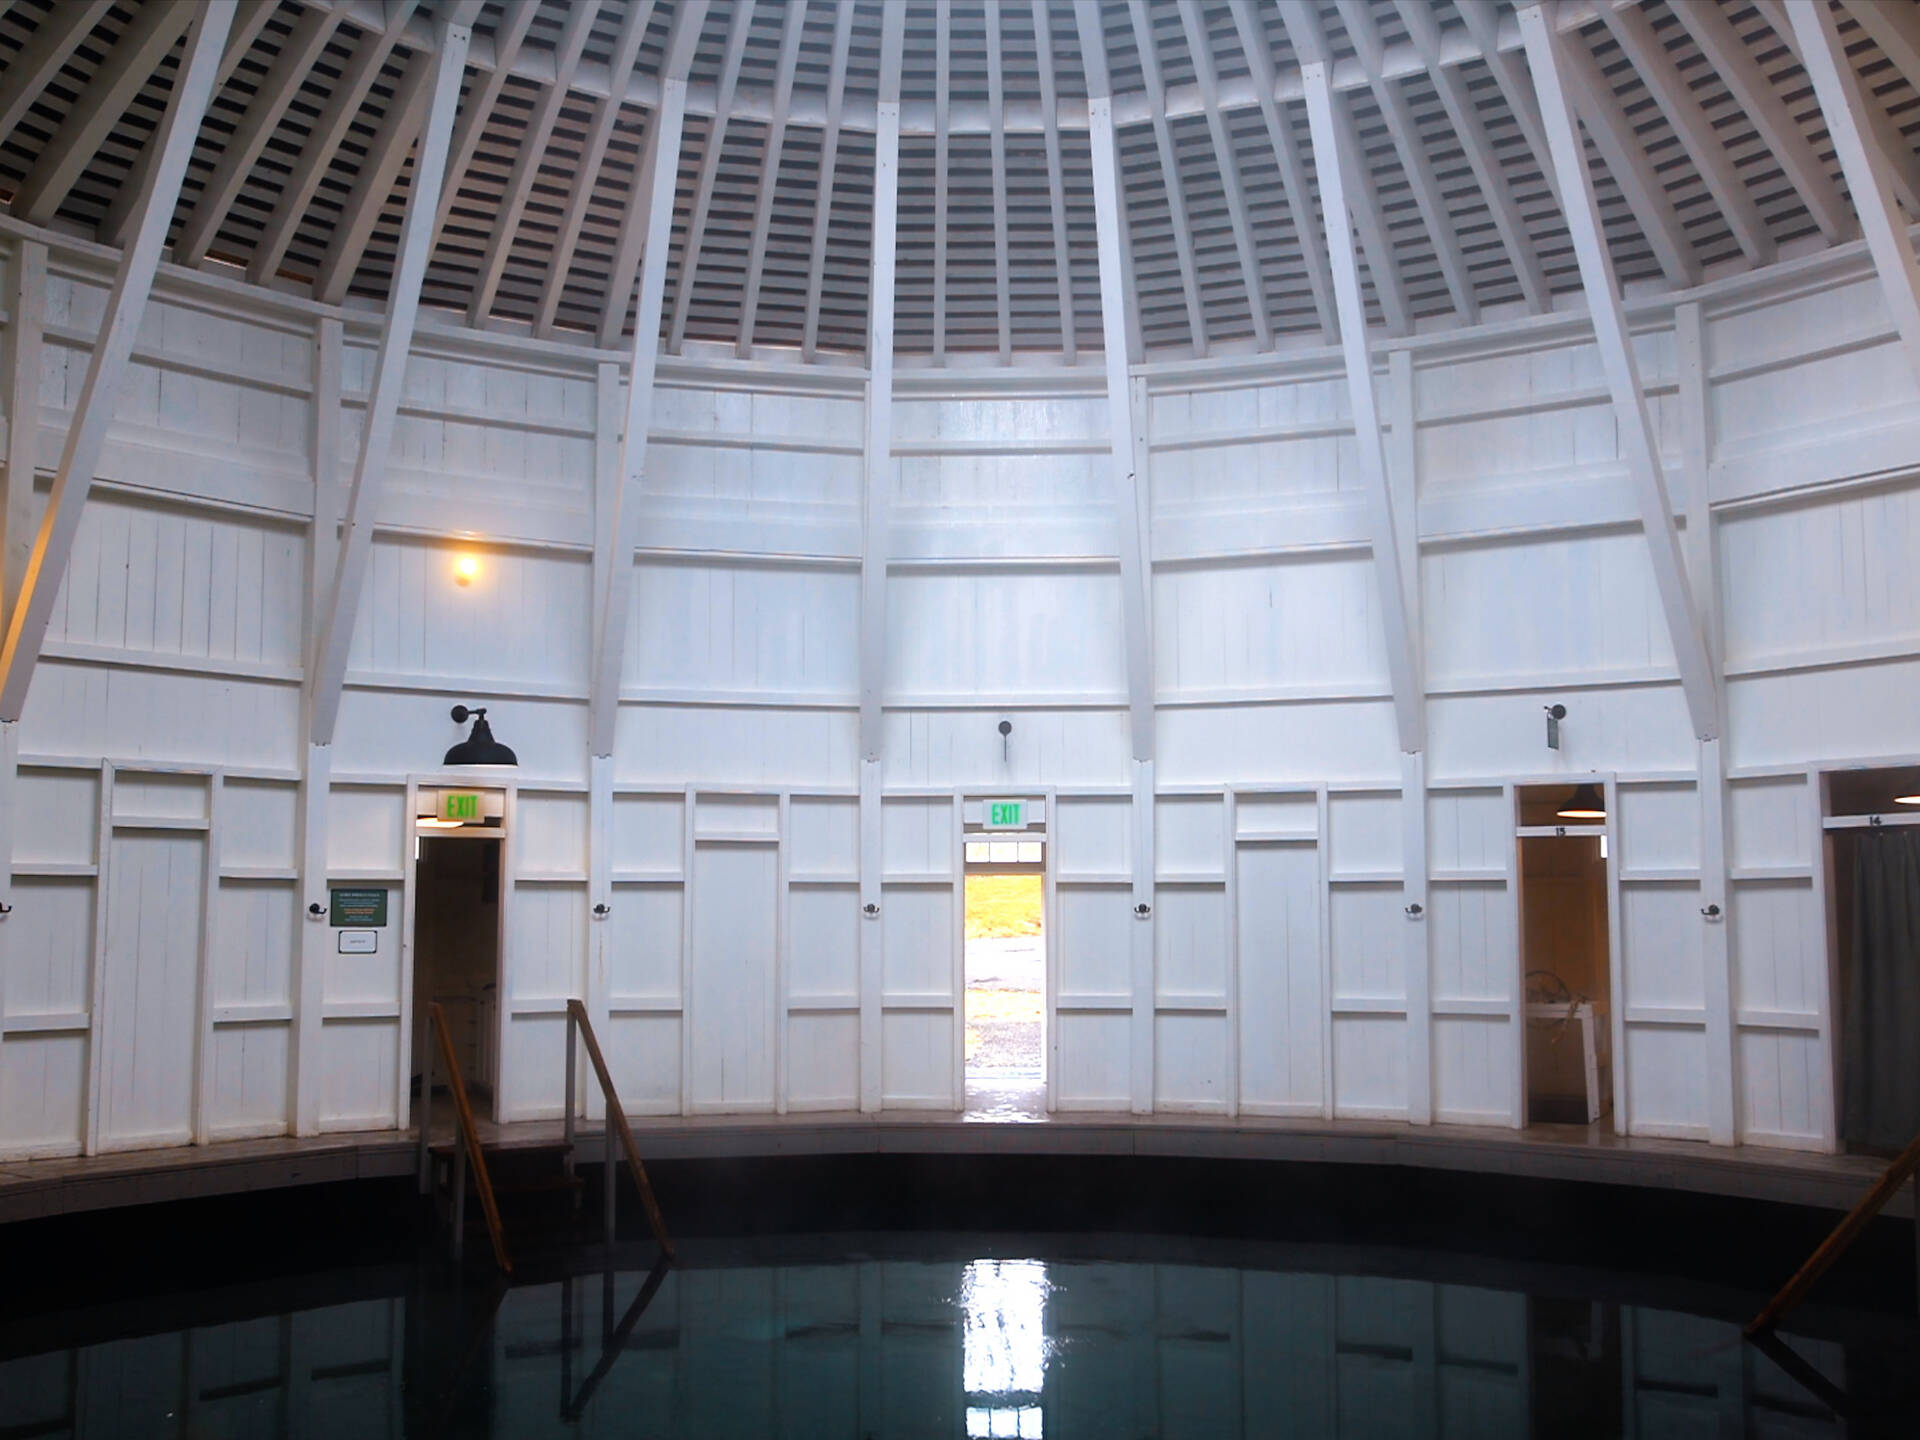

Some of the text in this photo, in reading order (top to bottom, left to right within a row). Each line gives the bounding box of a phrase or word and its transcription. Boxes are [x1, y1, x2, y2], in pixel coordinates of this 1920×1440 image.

[447, 795, 478, 817] EXIT
[991, 803, 1020, 825] EXIT
[1870, 816, 1882, 826] 14
